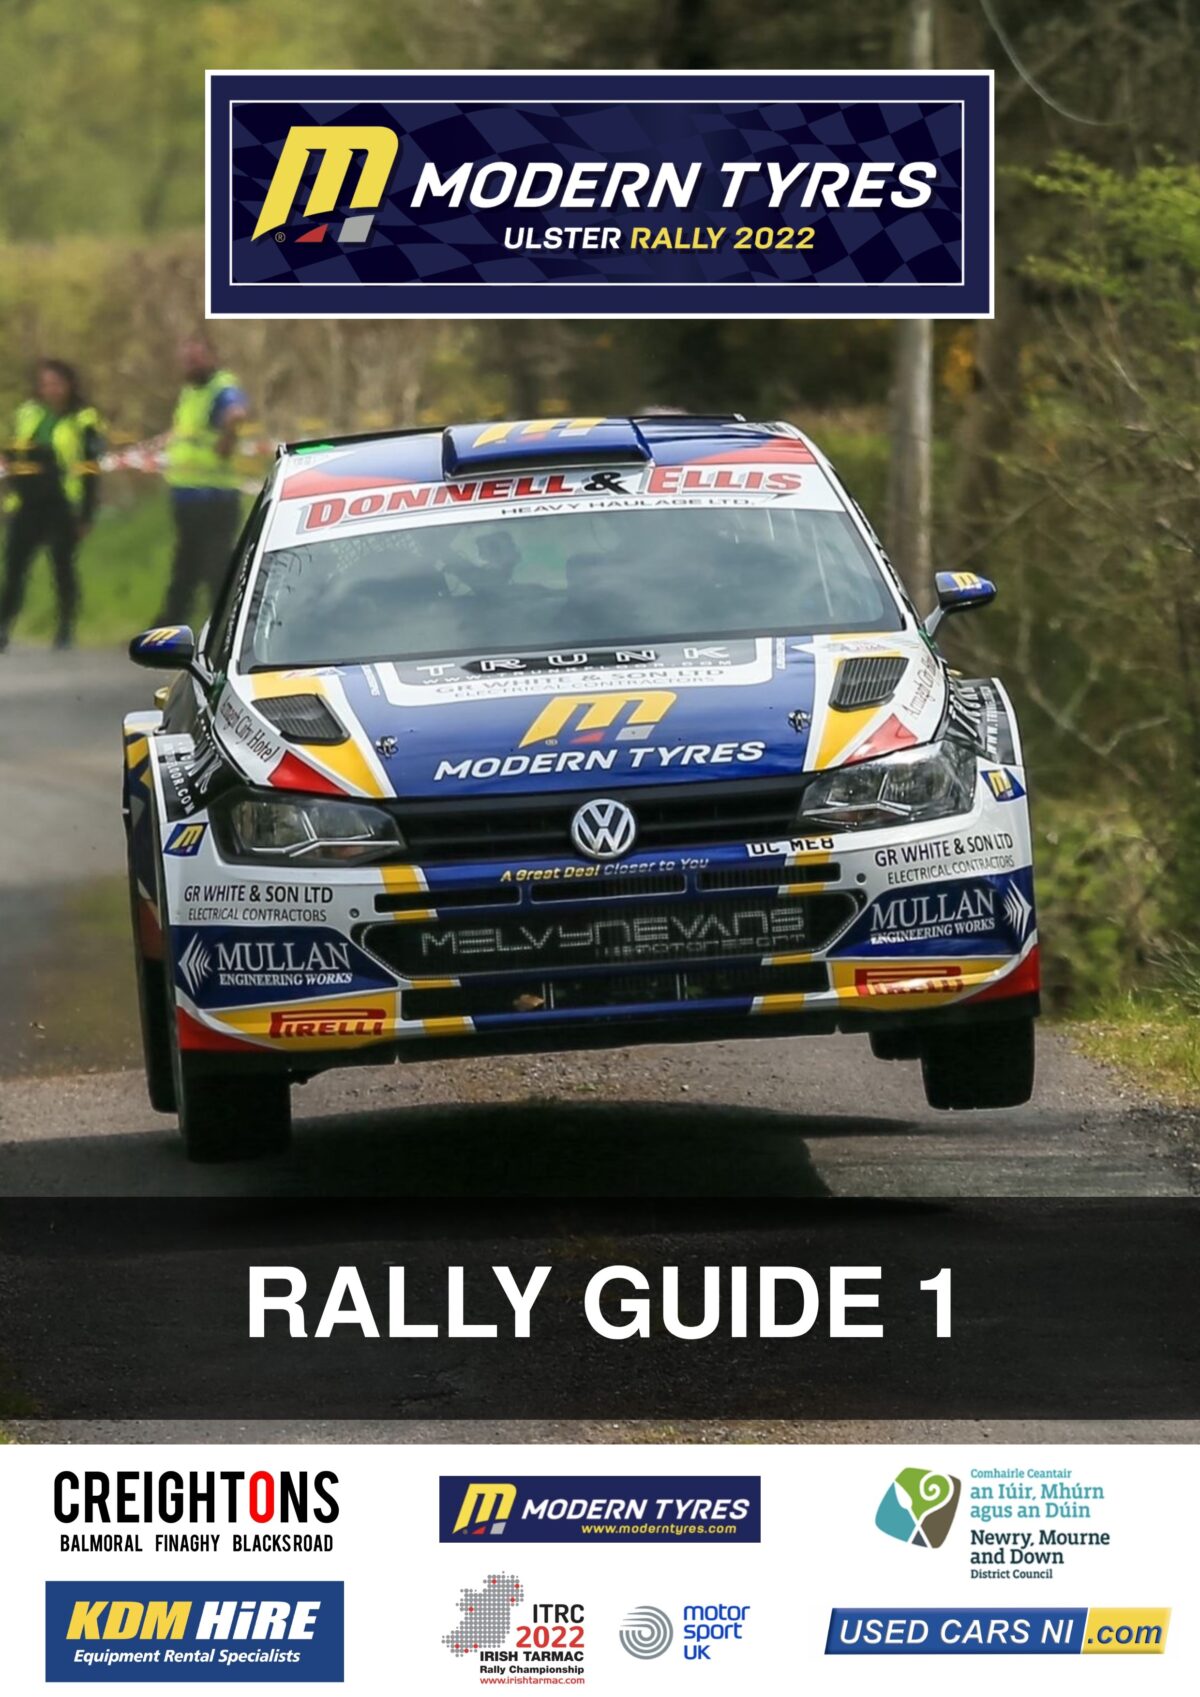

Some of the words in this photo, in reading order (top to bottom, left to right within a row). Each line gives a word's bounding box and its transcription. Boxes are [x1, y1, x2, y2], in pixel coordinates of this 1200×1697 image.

[302, 474, 574, 530] DONNELL
[584, 471, 631, 495] &
[647, 467, 802, 493] ELLIS
[502, 503, 580, 514] HEAVY
[589, 498, 703, 508] HAULAGE
[416, 646, 730, 677] TRUNK
[483, 676, 569, 689] WHITE
[612, 670, 668, 680] SON
[678, 668, 725, 677] LTD
[246, 729, 281, 763] Hotel
[433, 750, 613, 781] MODERN
[631, 741, 767, 769] TYRES
[874, 849, 899, 867] GR
[902, 840, 952, 864] WHITE
[953, 838, 966, 855] &
[967, 833, 994, 853] SON
[995, 832, 1014, 849] LTD
[500, 870, 512, 882] A
[515, 867, 561, 881] Great
[563, 864, 600, 878] Deal
[603, 862, 656, 876] Closer
[659, 860, 675, 872] to
[681, 858, 710, 870] You
[888, 864, 952, 885] ELECTRICAL
[952, 855, 1015, 875] CONTRACTORS
[184, 885, 201, 902] GR
[204, 885, 246, 902] WHITE
[249, 884, 262, 902] &
[265, 886, 299, 903] SON
[304, 887, 334, 904] LTD
[188, 907, 239, 921] ELECTRICAL
[242, 908, 328, 923] CONTRACTORS
[870, 888, 996, 932] MULLAN
[870, 923, 953, 945] ENGINEERING
[955, 917, 996, 935] WORKS
[215, 942, 351, 971] MULLAN
[219, 973, 303, 986] ENGINEERING
[305, 973, 353, 986] WORKS
[269, 1008, 387, 1038] PIRELLI
